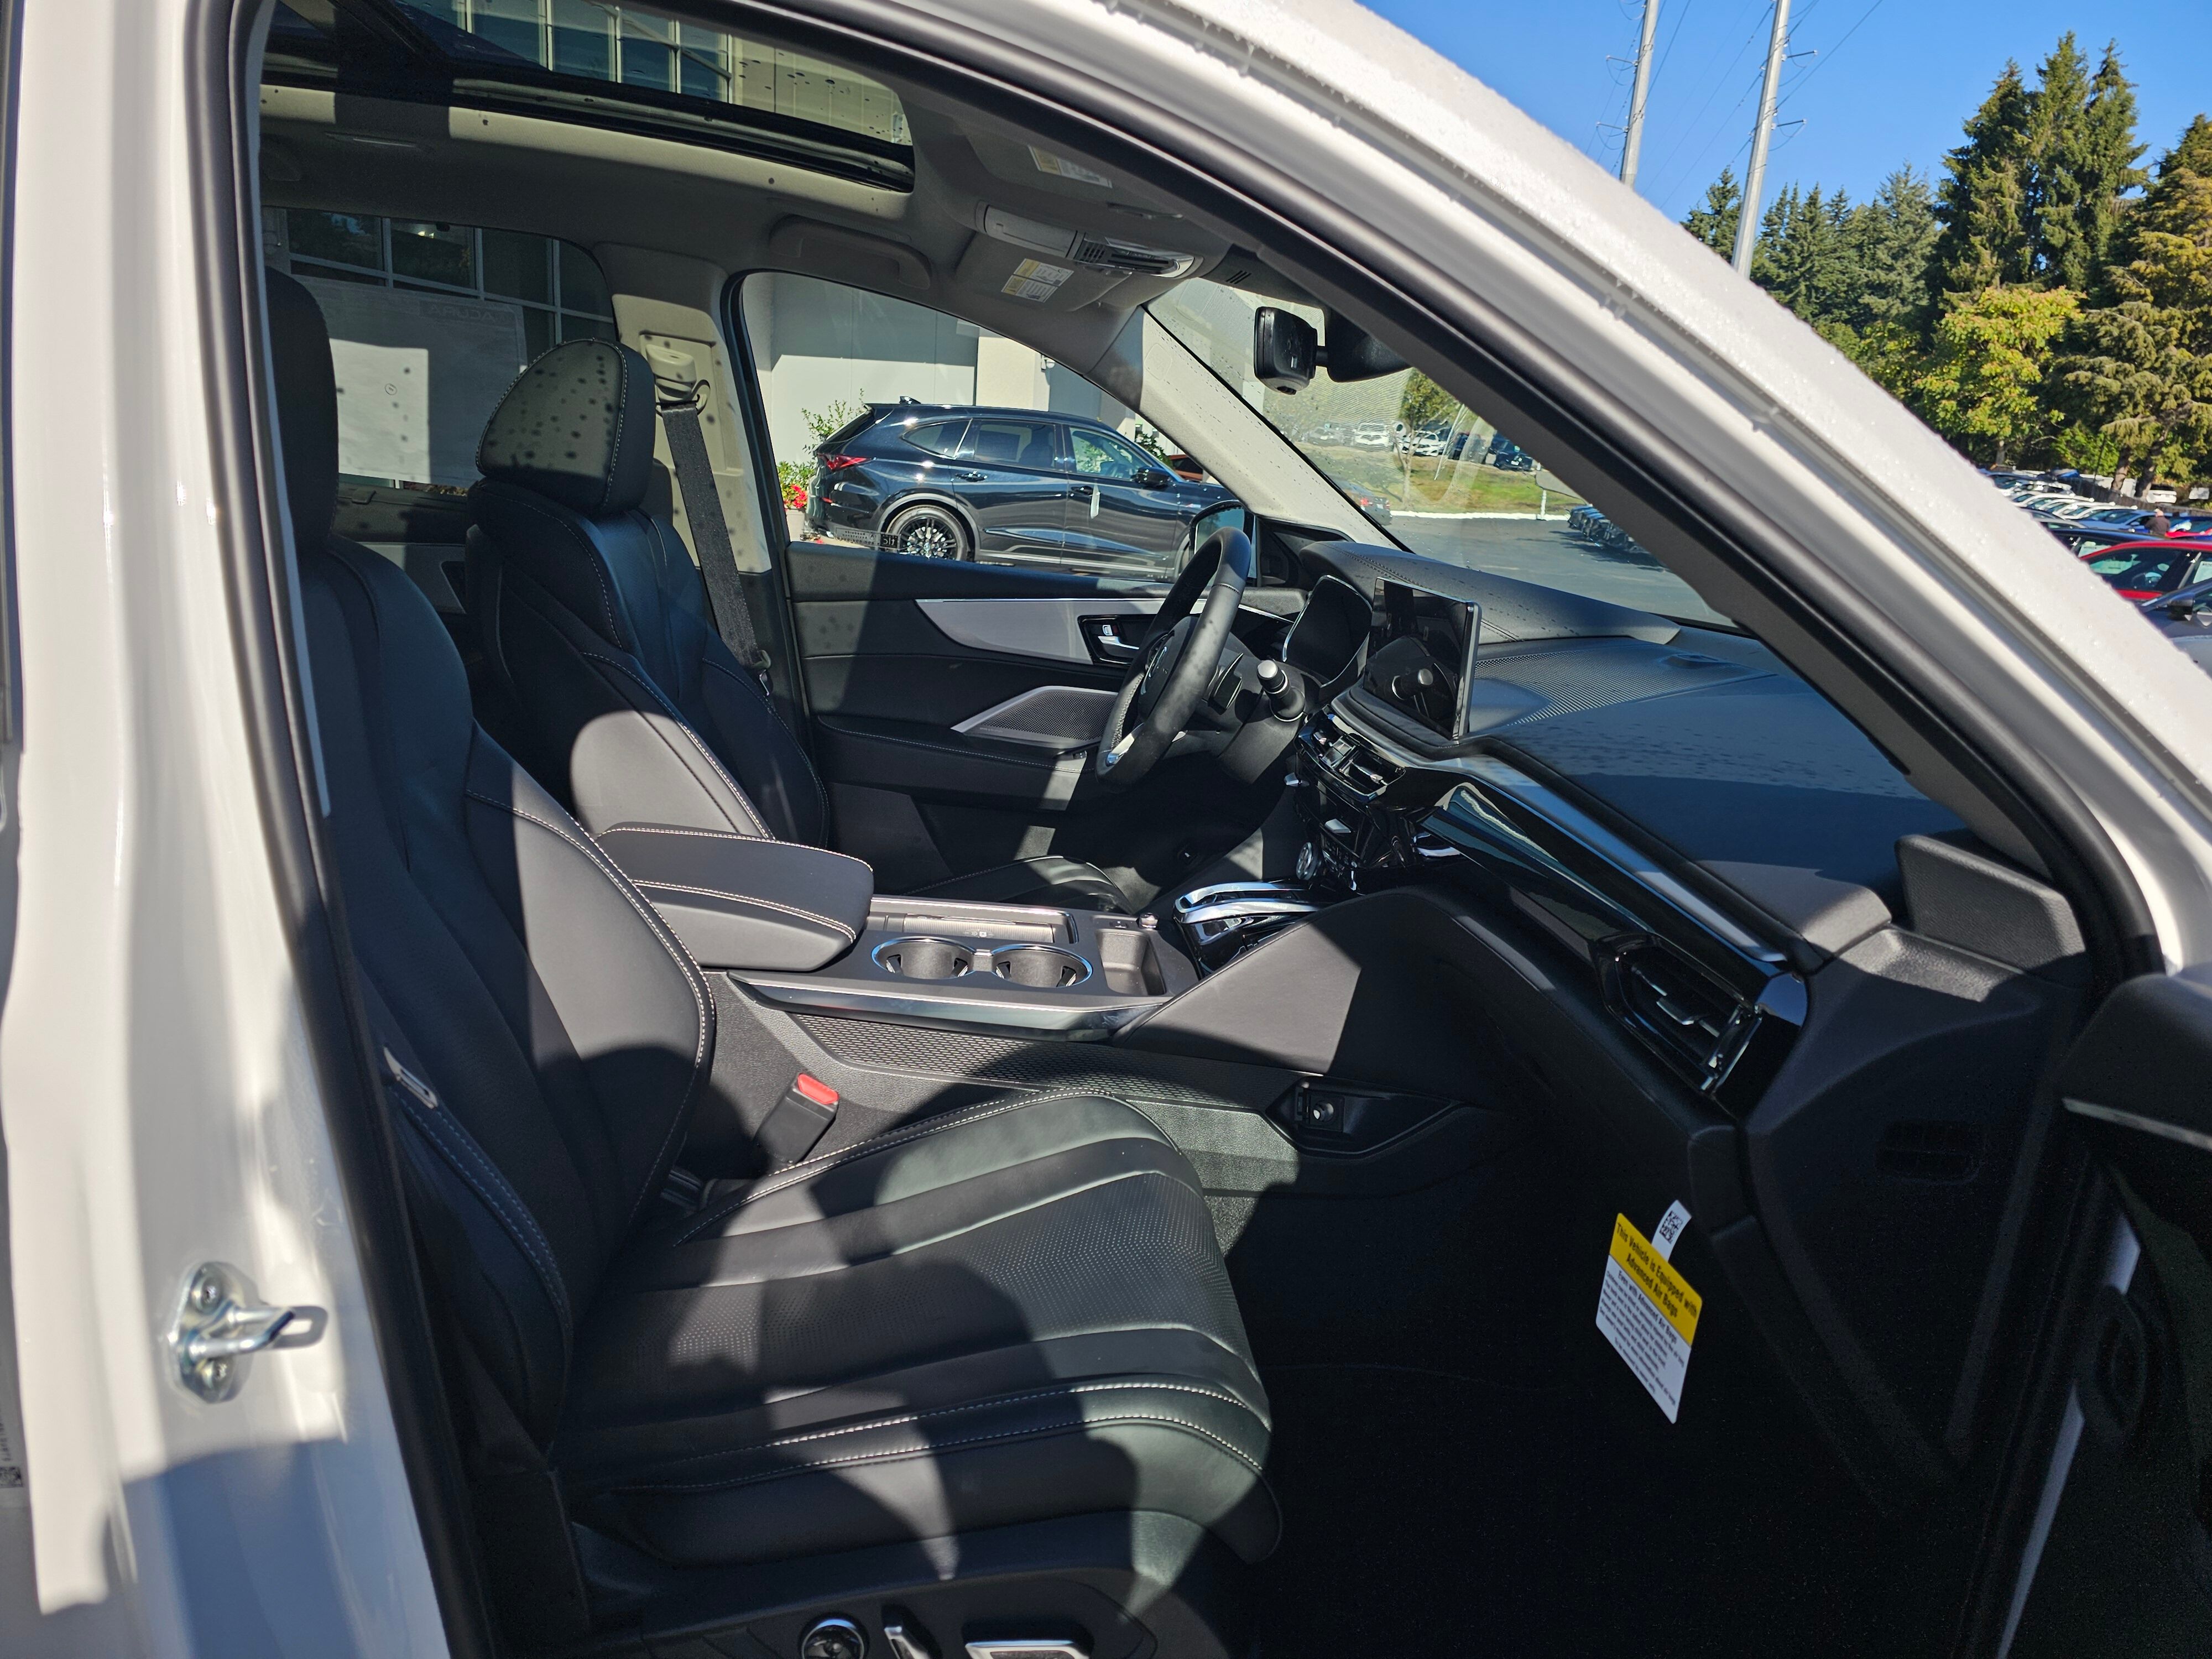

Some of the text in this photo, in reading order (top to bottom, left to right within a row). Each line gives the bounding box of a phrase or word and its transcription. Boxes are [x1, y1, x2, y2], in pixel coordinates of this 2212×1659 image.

[1617, 1222, 1697, 1319] This Vehicle is Equipped with
[1626, 1253, 1678, 1318] Advanced Air Bags
